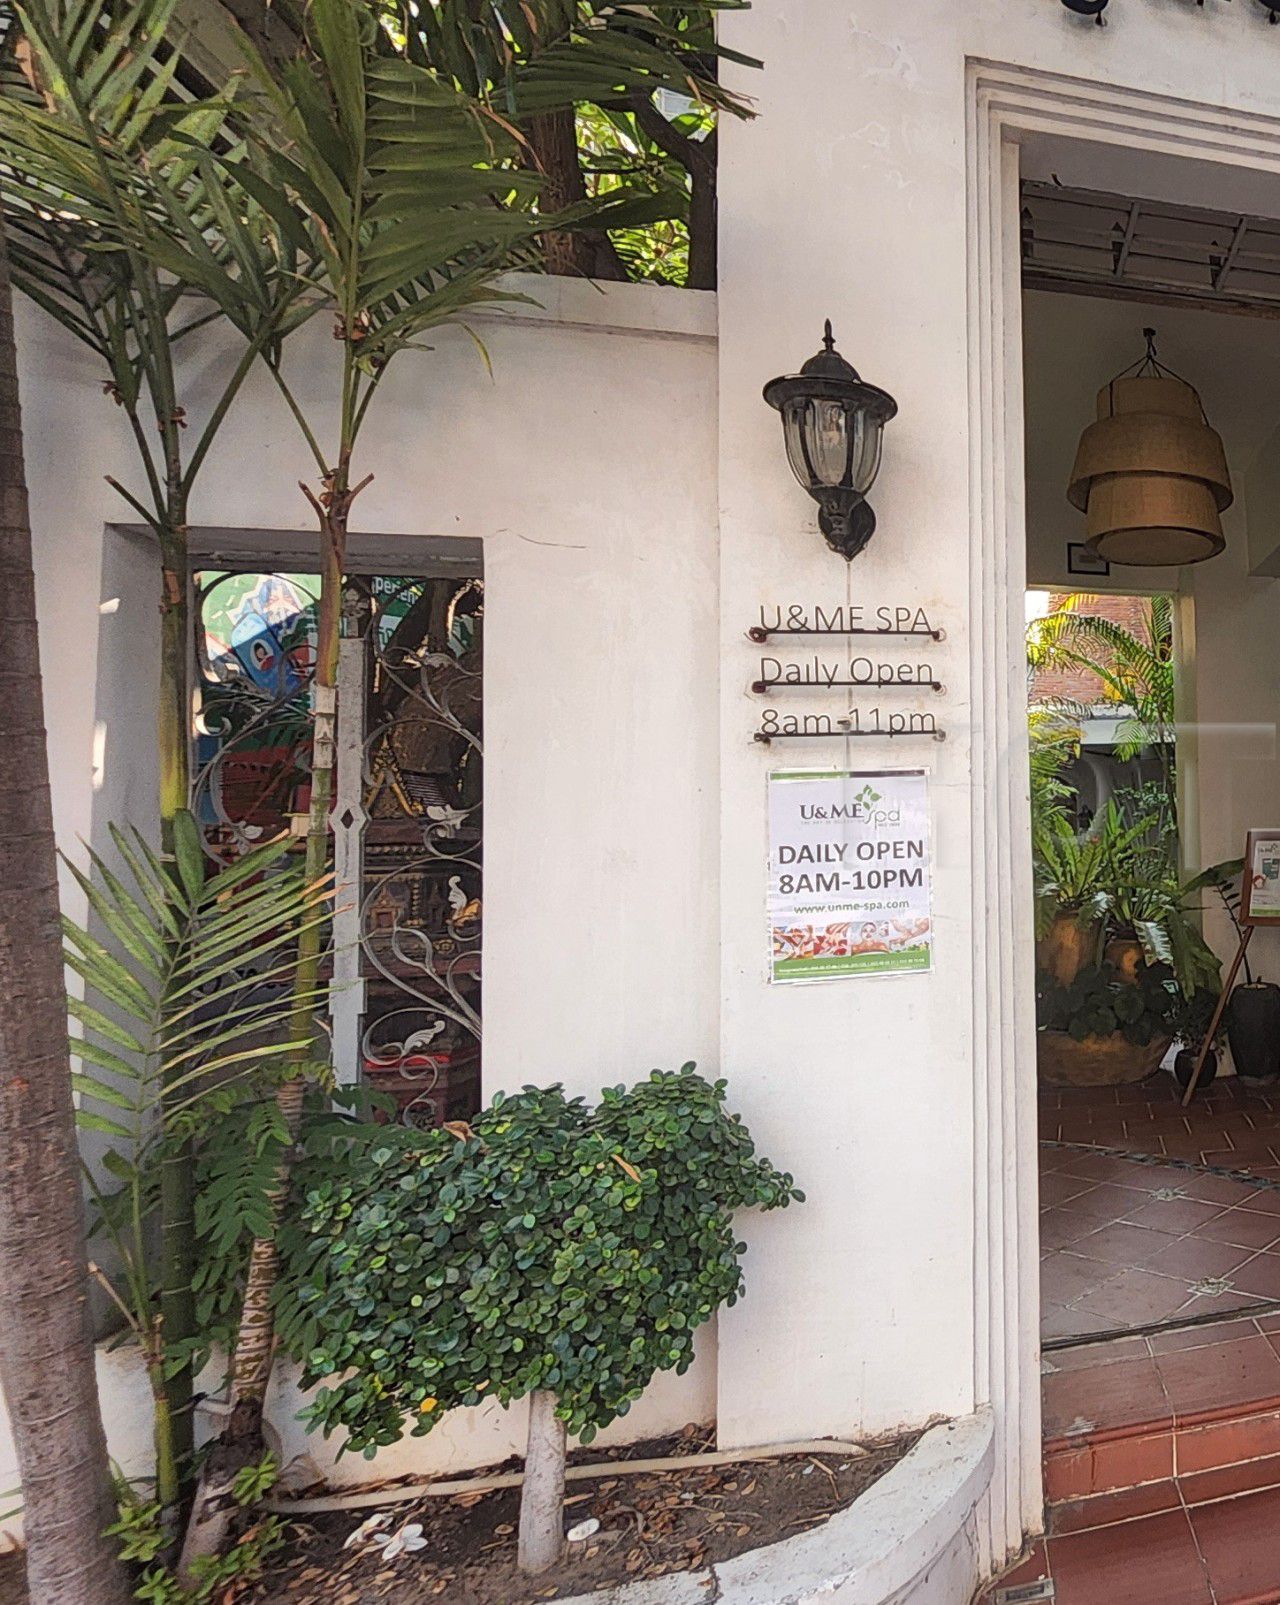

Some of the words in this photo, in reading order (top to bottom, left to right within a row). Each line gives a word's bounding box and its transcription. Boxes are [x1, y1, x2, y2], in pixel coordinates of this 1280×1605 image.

[760, 605, 864, 632] U&ME
[876, 606, 932, 632] SPA
[761, 656, 839, 689] Daily
[850, 657, 932, 689] Open
[800, 804, 864, 820] U&ME
[778, 843, 849, 865] DAILY
[856, 840, 924, 861] OPEN
[778, 868, 923, 895] 8AM-10PM
[793, 899, 910, 915] www.unme-spa.com
